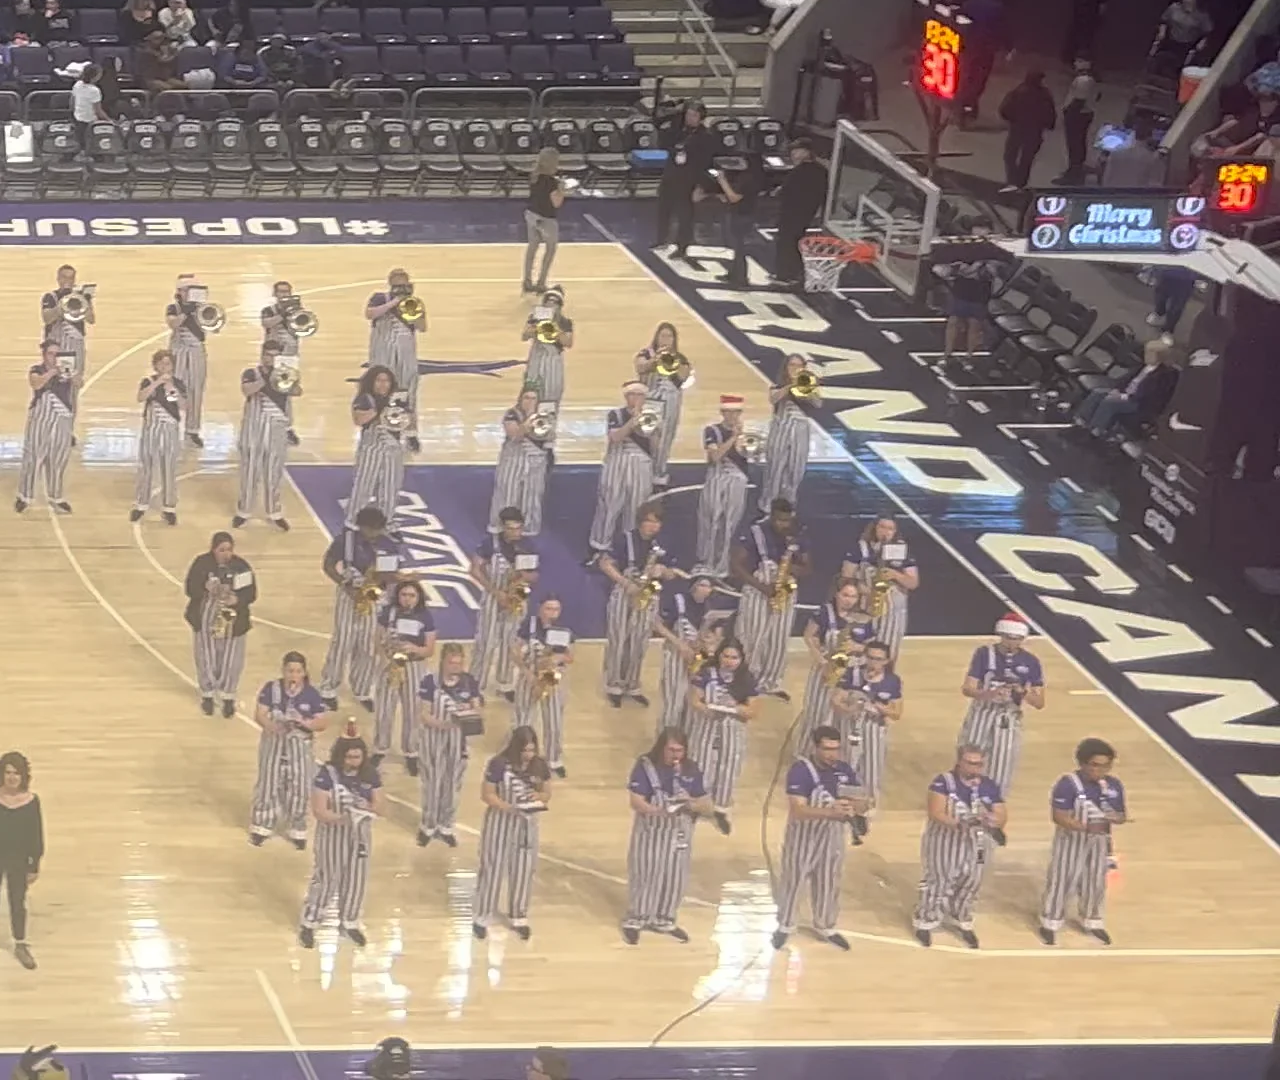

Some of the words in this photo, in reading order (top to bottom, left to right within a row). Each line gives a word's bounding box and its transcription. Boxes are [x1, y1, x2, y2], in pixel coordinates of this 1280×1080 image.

[924, 43, 957, 98] 30
[1086, 203, 1153, 227] Merry
[1218, 183, 1257, 211] 30
[976, 532, 1280, 799] CAN
